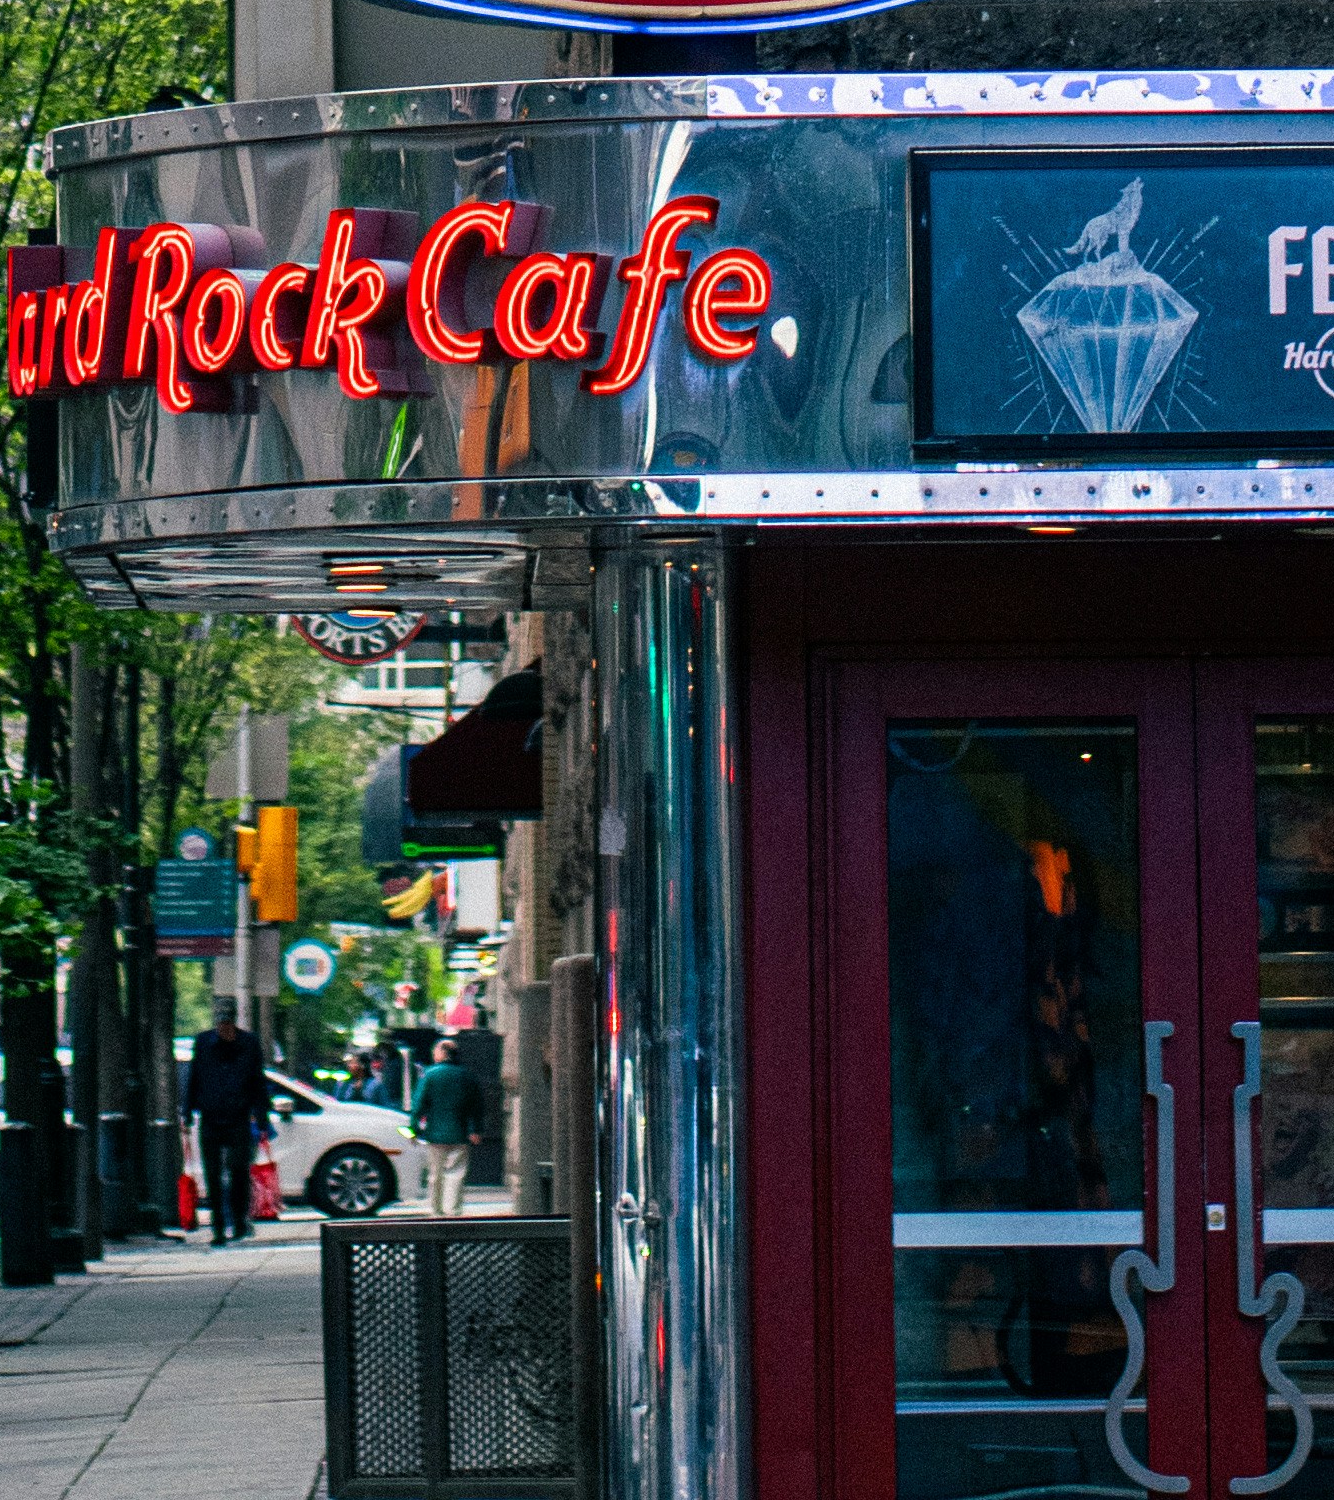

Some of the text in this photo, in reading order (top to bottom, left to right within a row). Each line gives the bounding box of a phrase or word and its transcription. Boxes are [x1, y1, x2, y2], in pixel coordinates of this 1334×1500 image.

[8, 196, 771, 413] ard Rock Cafe
[309, 617, 387, 654] ORTS
